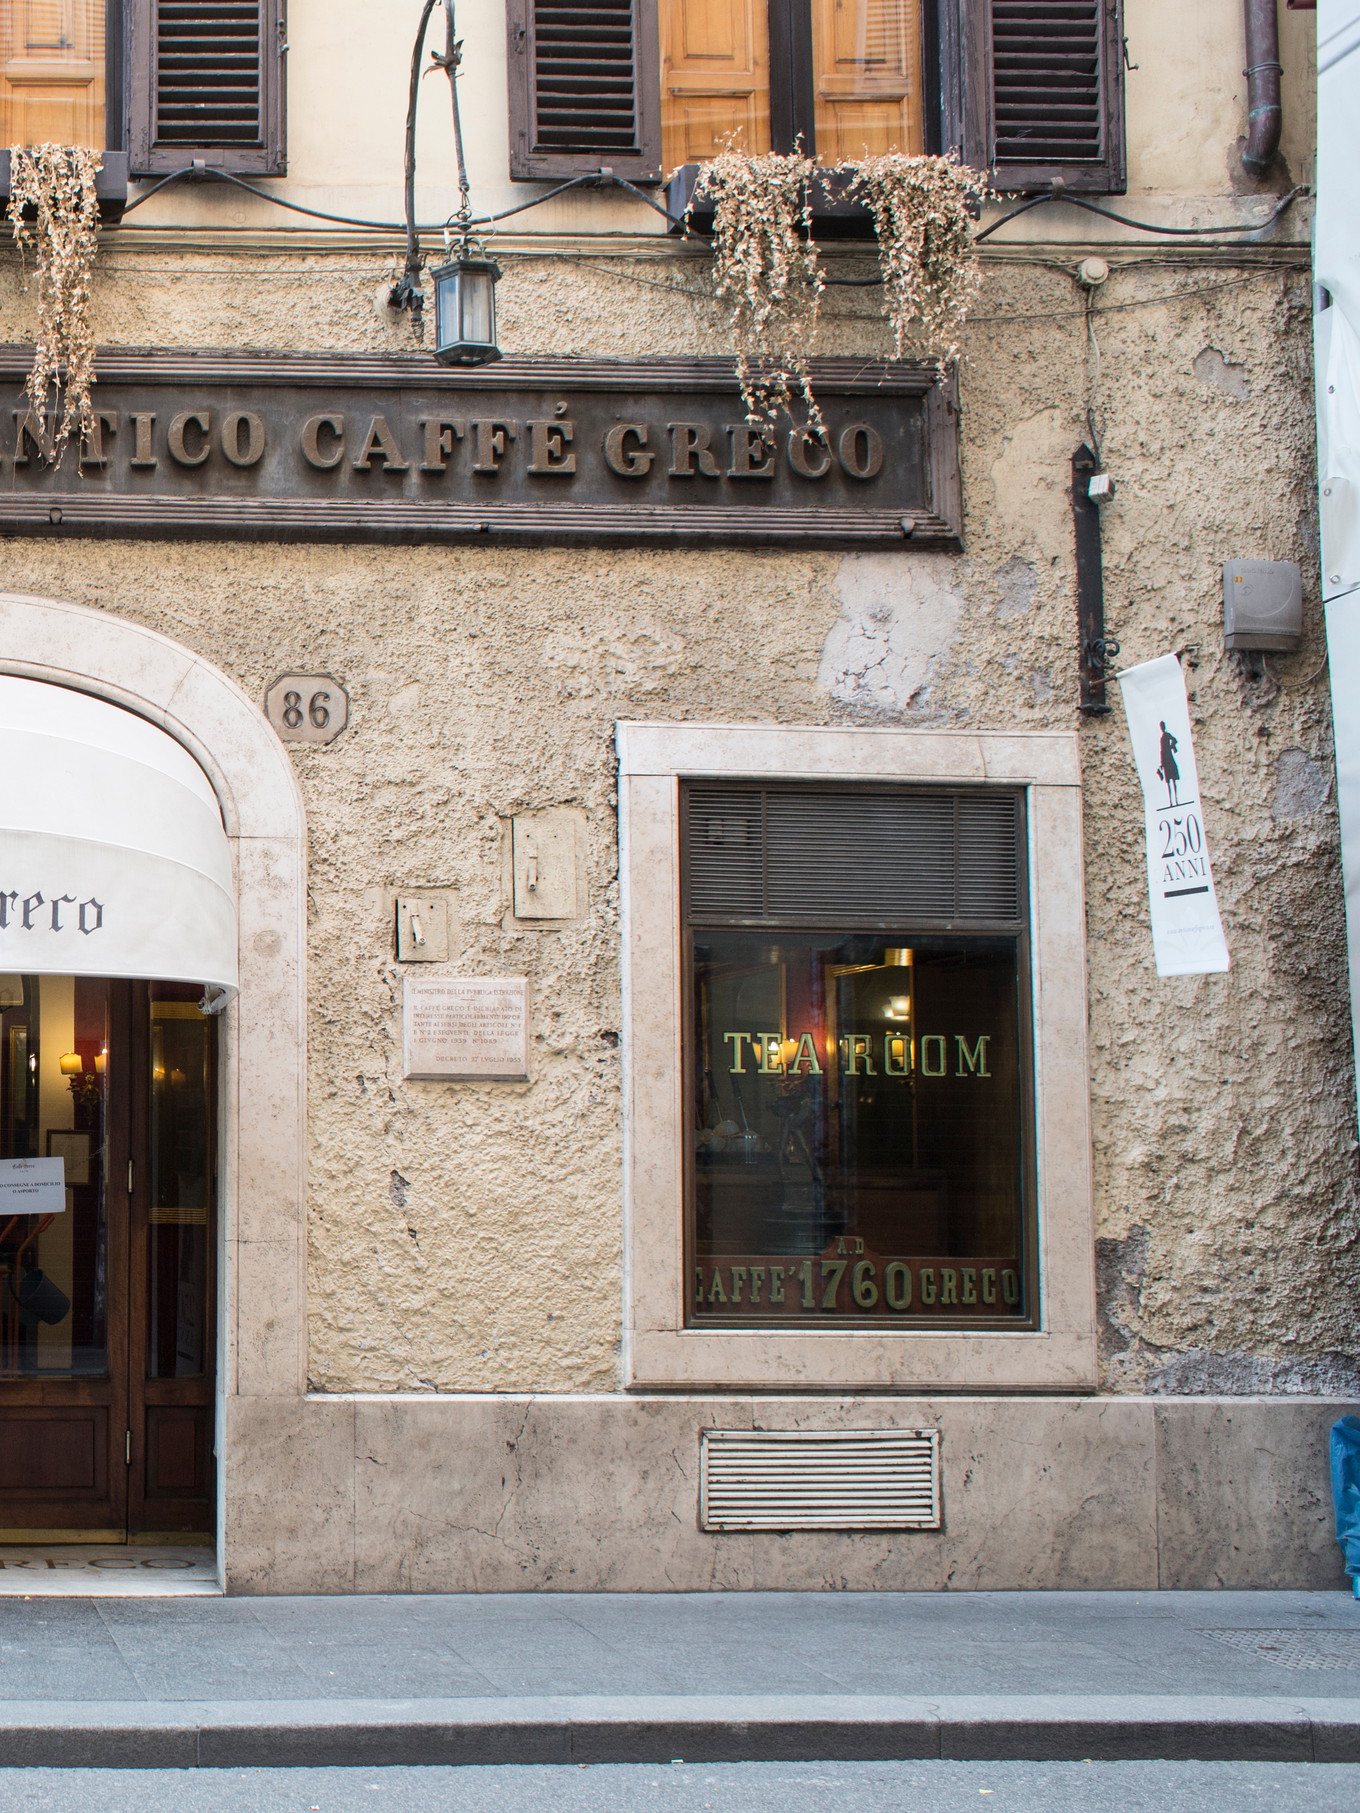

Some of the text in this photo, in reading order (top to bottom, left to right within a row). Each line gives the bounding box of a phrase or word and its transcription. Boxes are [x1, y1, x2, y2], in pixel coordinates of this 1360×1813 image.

[300, 401, 577, 474] CAFFÉ
[604, 422, 884, 479] GRECO
[282, 690, 331, 729] 86
[1159, 813, 1203, 859] 250
[1162, 856, 1207, 883] ANNI
[723, 1031, 992, 1078] TEA ROOM
[798, 1260, 913, 1310] 1760
[920, 1267, 1019, 1306] GRECO
